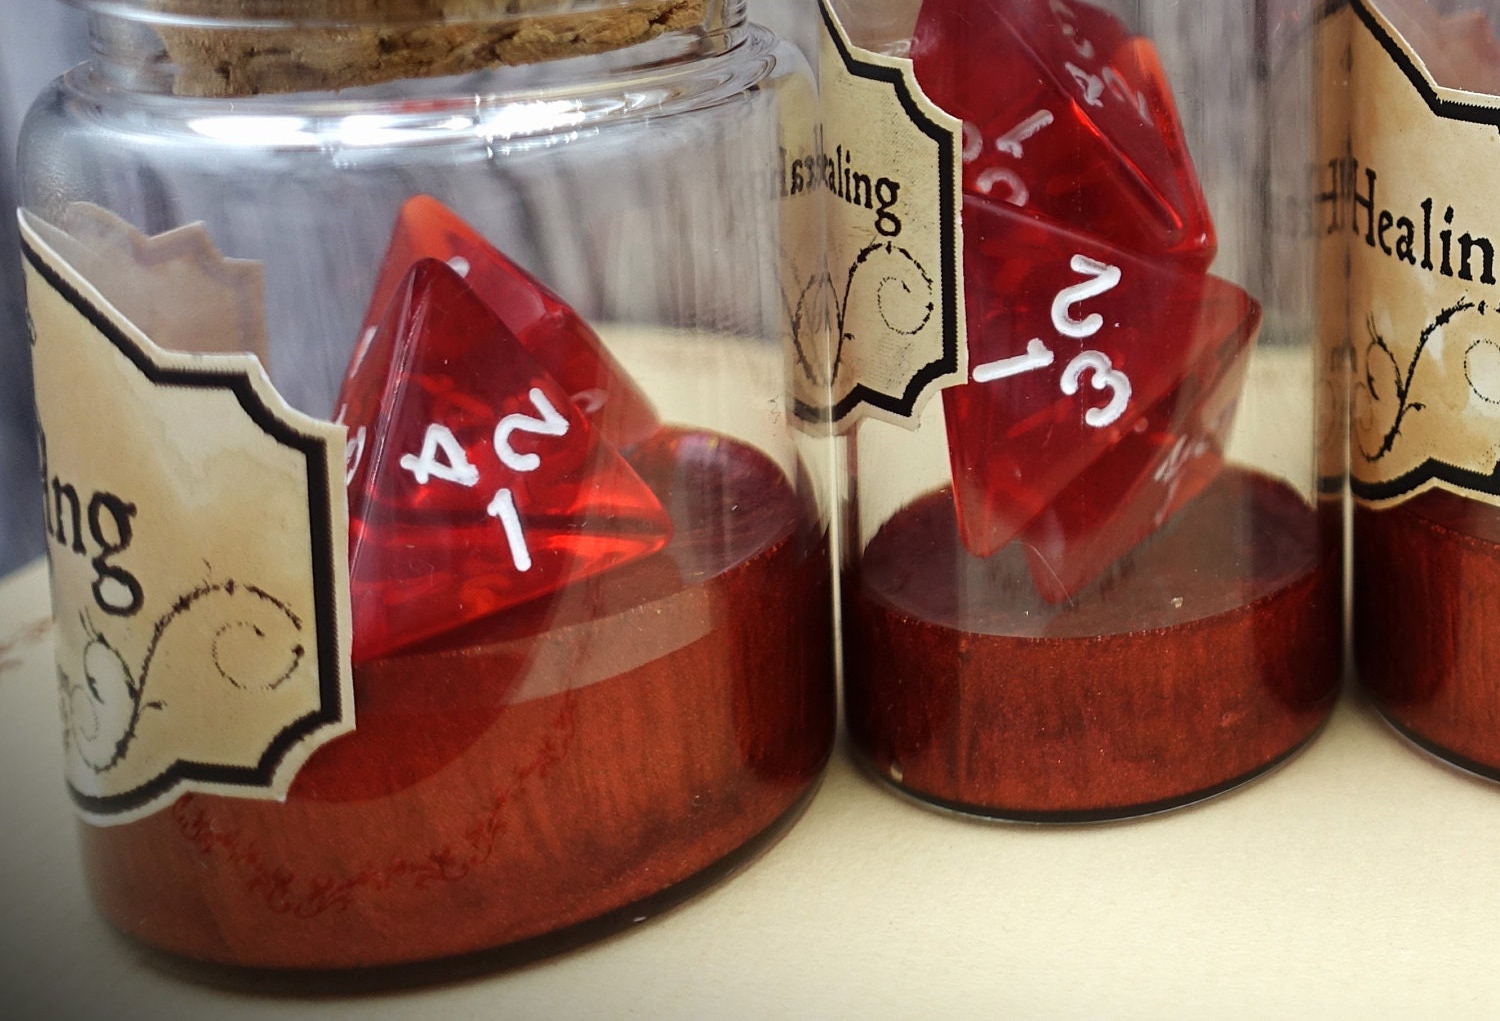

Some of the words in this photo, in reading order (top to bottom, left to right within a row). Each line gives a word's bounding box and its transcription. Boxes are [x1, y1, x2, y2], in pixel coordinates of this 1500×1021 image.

[996, 109, 1055, 159] 1
[1052, 254, 1122, 338] 2
[972, 339, 1054, 383] 1
[1060, 349, 1132, 428] 3
[401, 423, 479, 487] 4
[494, 387, 569, 472] 2
[487, 488, 532, 572] 1
